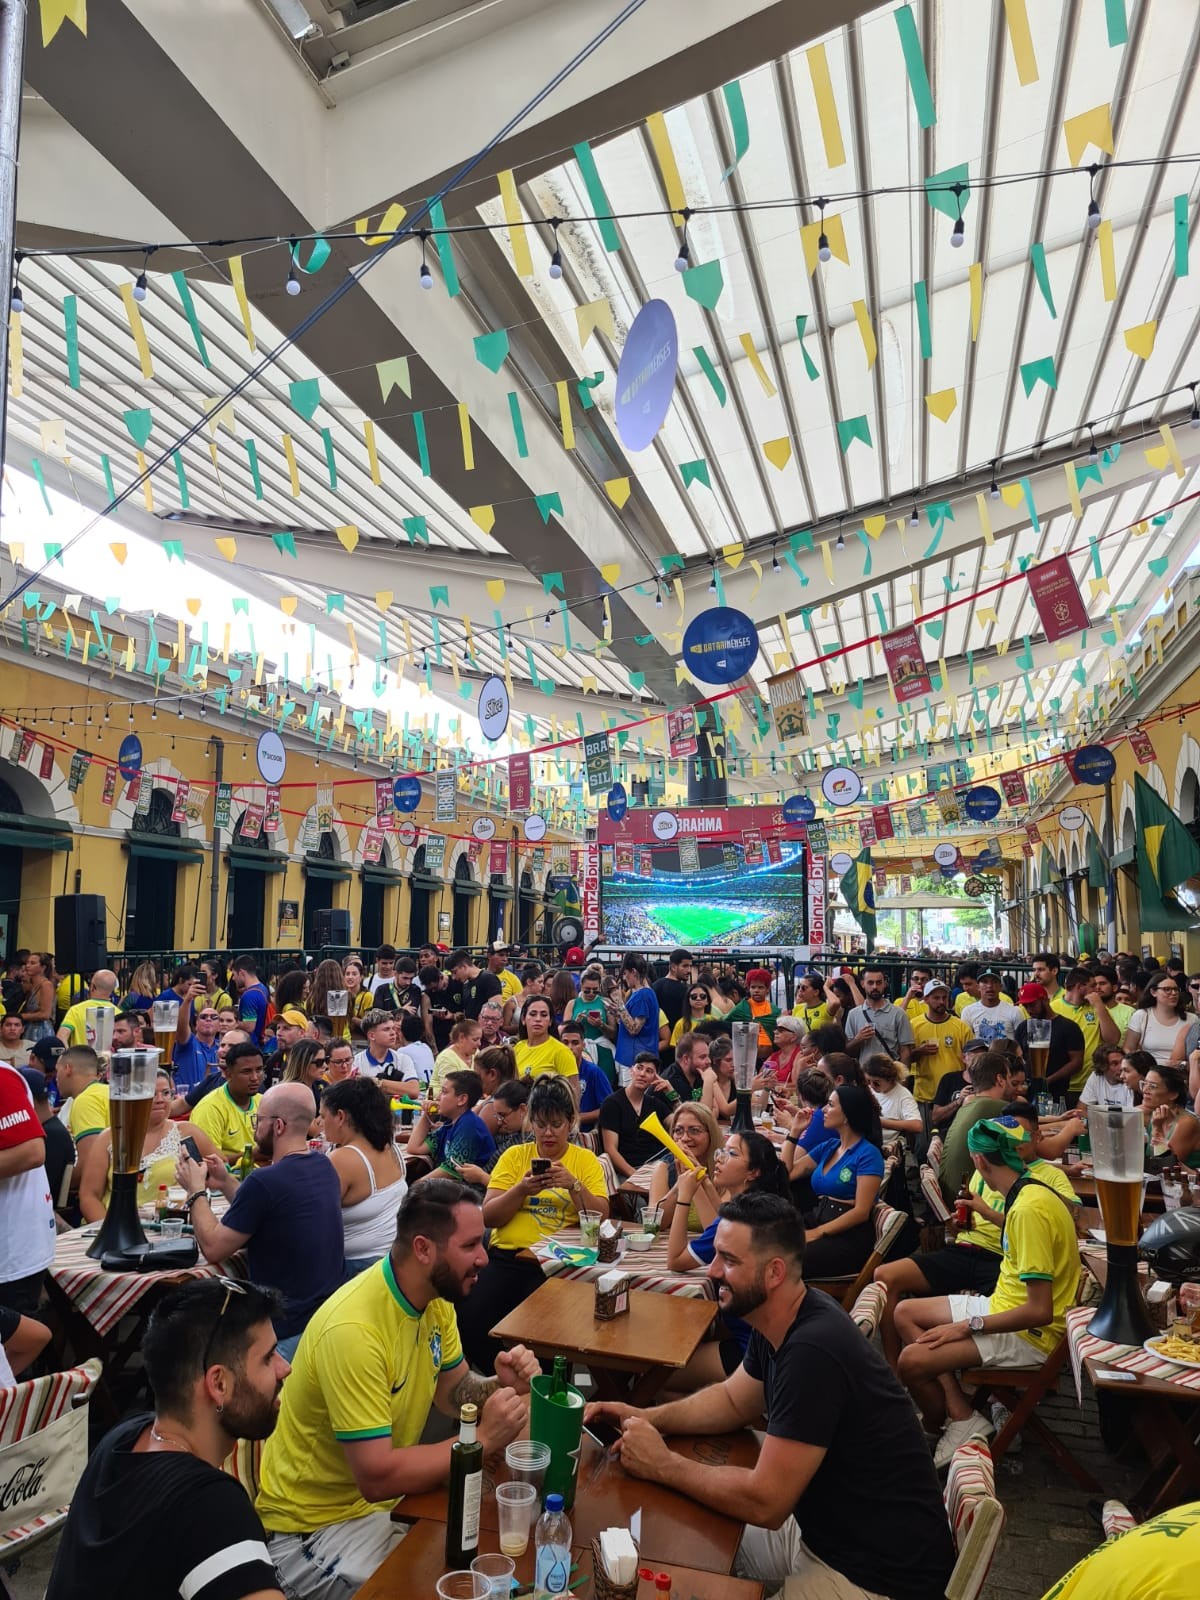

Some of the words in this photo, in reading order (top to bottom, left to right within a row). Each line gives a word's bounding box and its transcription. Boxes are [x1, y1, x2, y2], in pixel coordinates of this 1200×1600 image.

[586, 740, 608, 756] BRA
[589, 771, 611, 787] SIL
[677, 817, 722, 832] BRAHMA
[587, 891, 599, 929] DINIZ
[813, 895, 824, 930] DINIZ
